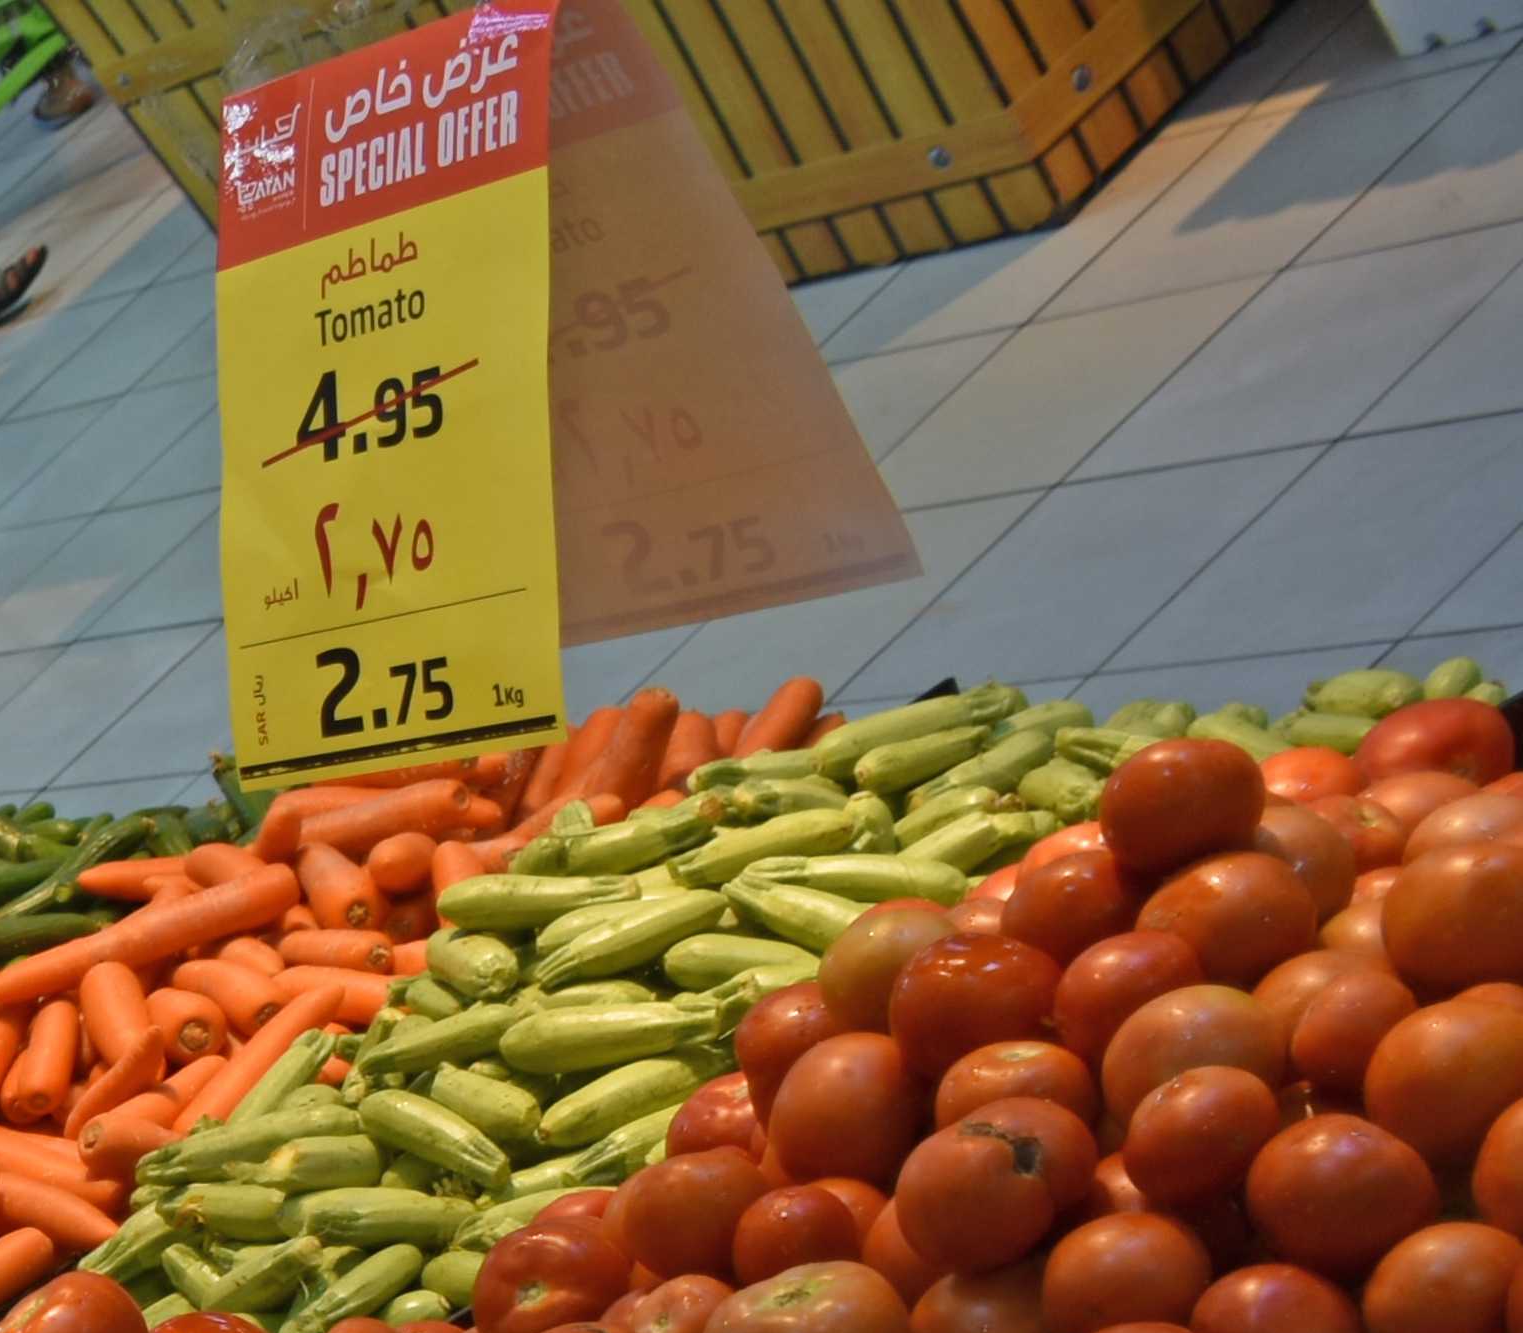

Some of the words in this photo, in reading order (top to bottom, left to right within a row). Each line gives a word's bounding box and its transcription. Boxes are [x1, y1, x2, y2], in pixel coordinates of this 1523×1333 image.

[324, 59, 412, 144] خاص
[422, 34, 519, 109] عرض
[319, 121, 426, 208] SPECIAL
[436, 89, 518, 168] OFFER
[321, 231, 418, 300] طماطم
[314, 289, 425, 347] Tomato
[296, 366, 444, 463] 4.95
[257, 711, 269, 746] SAR
[316, 646, 454, 738] 2.75
[492, 683, 524, 708] 1Kg
